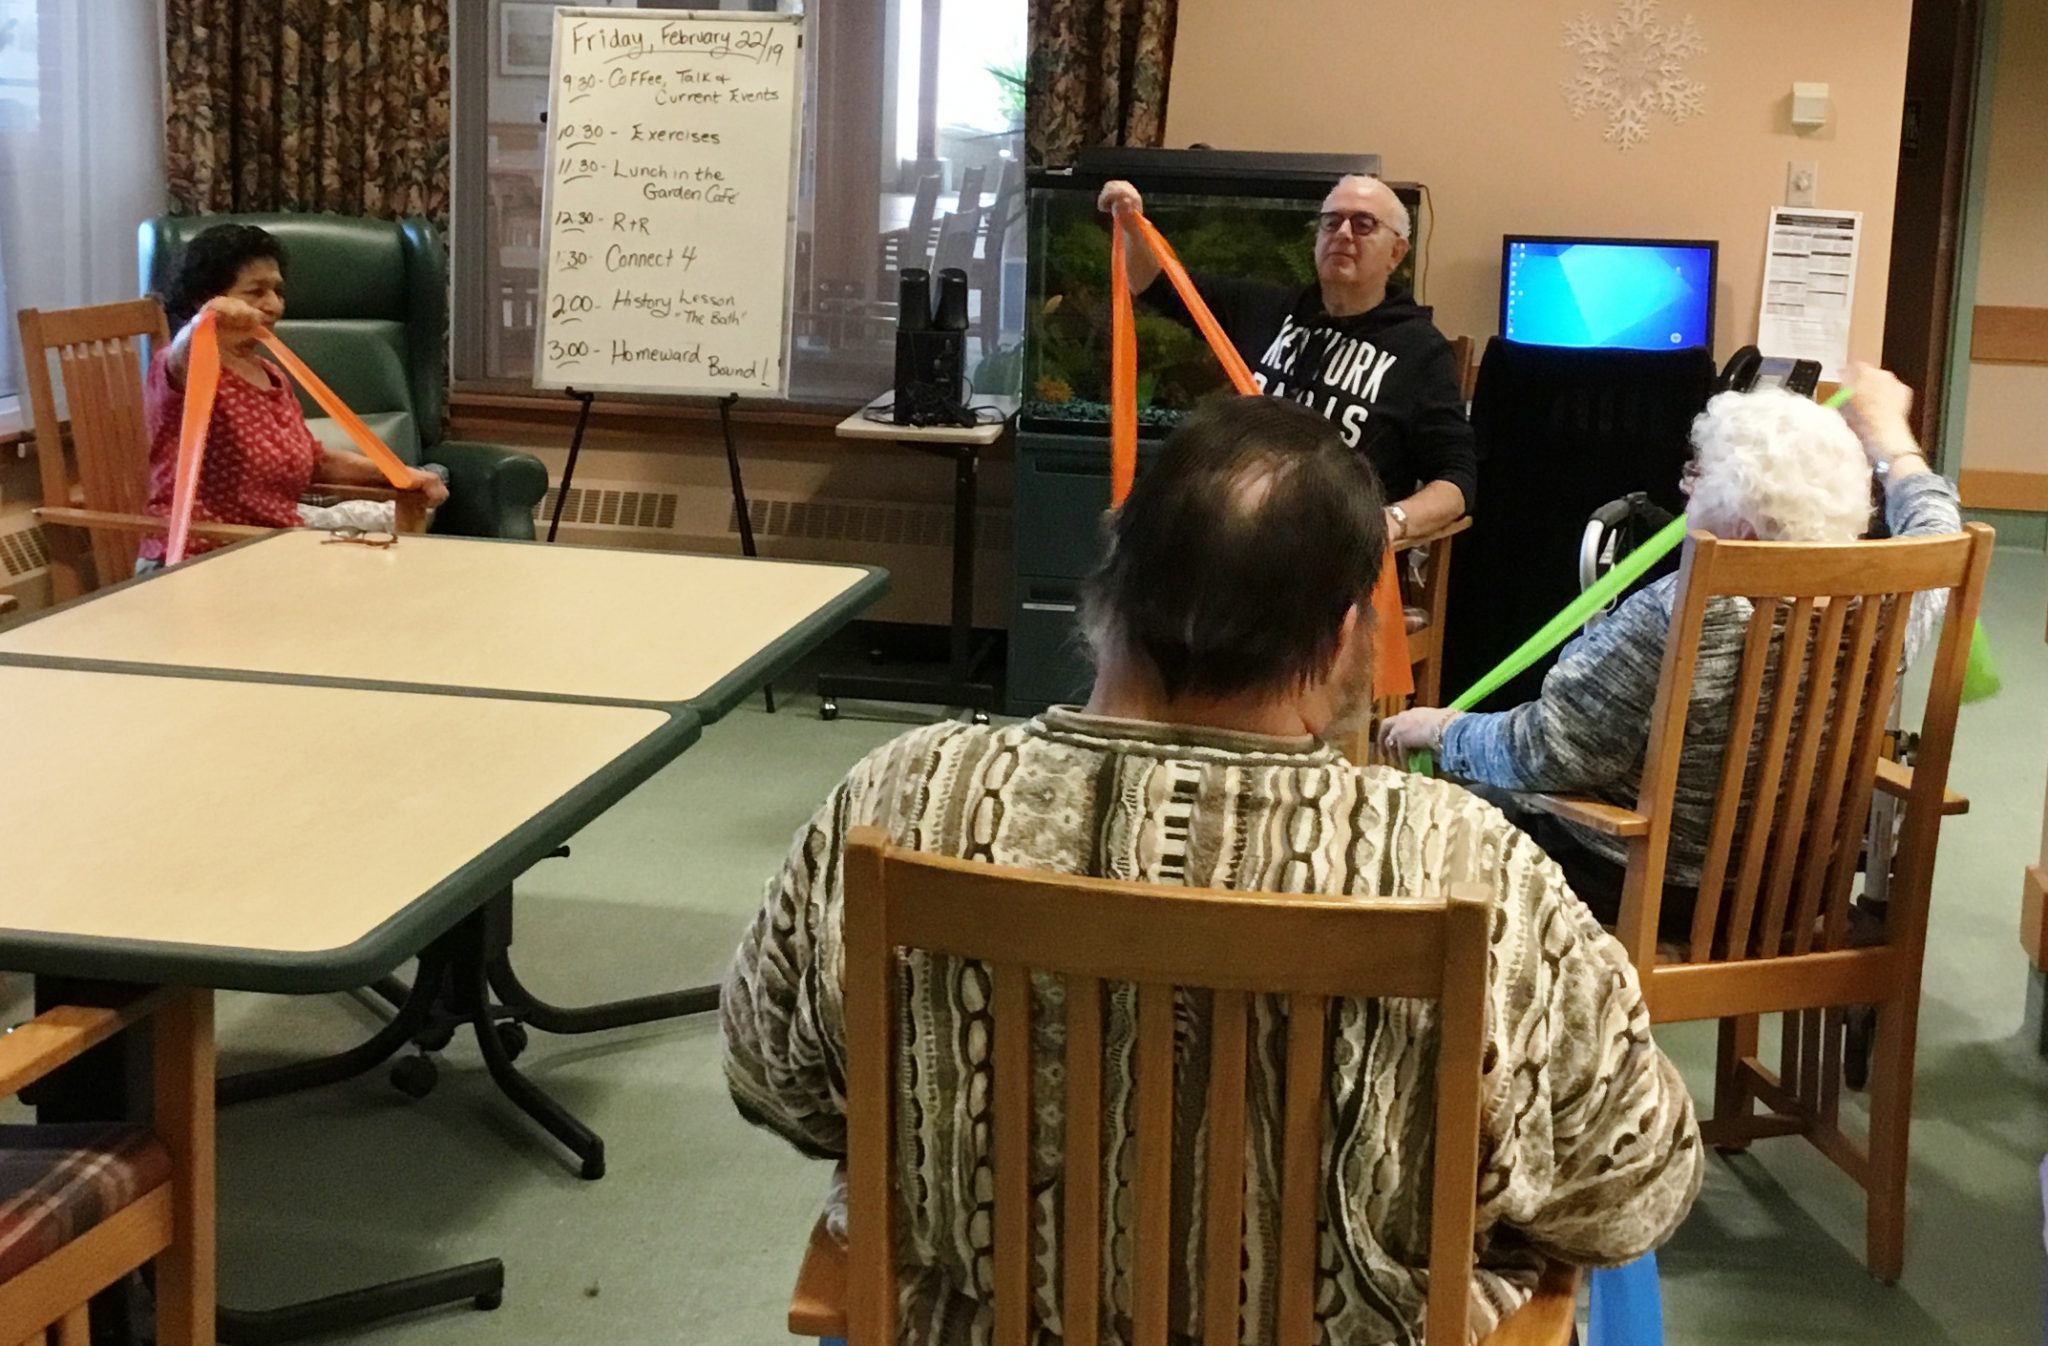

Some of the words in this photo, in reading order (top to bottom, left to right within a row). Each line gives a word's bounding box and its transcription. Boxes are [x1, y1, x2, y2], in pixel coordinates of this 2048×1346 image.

[572, 22, 653, 59] Friday,
[661, 22, 731, 57] February
[735, 27, 783, 66] 22/19
[656, 89, 722, 105] Current
[730, 87, 779, 104] Events
[631, 123, 721, 144] Exercises
[613, 159, 668, 179] Lunch
[673, 168, 689, 179] in
[694, 167, 725, 181] the
[643, 182, 701, 201] Garden
[606, 244, 674, 272] Connect
[681, 246, 698, 271] 4
[612, 289, 671, 318] History
[679, 289, 735, 306] Lesson
[611, 340, 701, 365] Homeward
